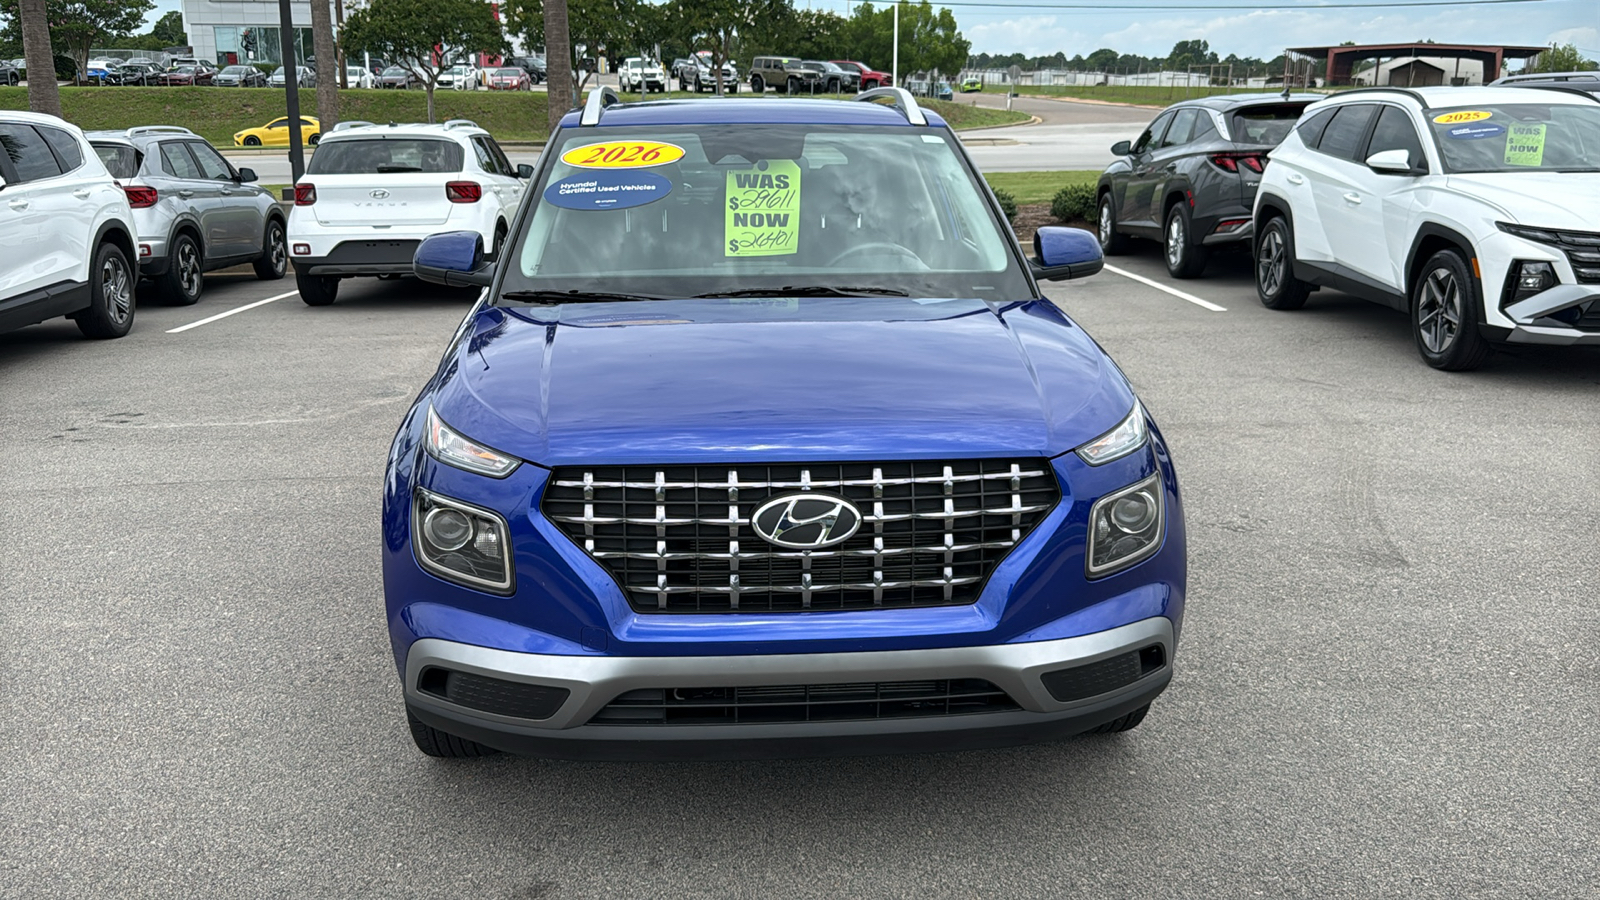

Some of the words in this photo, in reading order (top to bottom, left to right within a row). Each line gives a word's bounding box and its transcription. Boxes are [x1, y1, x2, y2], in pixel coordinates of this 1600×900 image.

[1445, 112, 1480, 122] 2025
[1513, 127, 1541, 135] WAS
[1509, 145, 1539, 153] NOW
[580, 146, 668, 163] 2026
[560, 181, 597, 190] Hyundai
[735, 174, 790, 189] WAS
[559, 187, 596, 195] Certified
[733, 213, 790, 228] NOW
